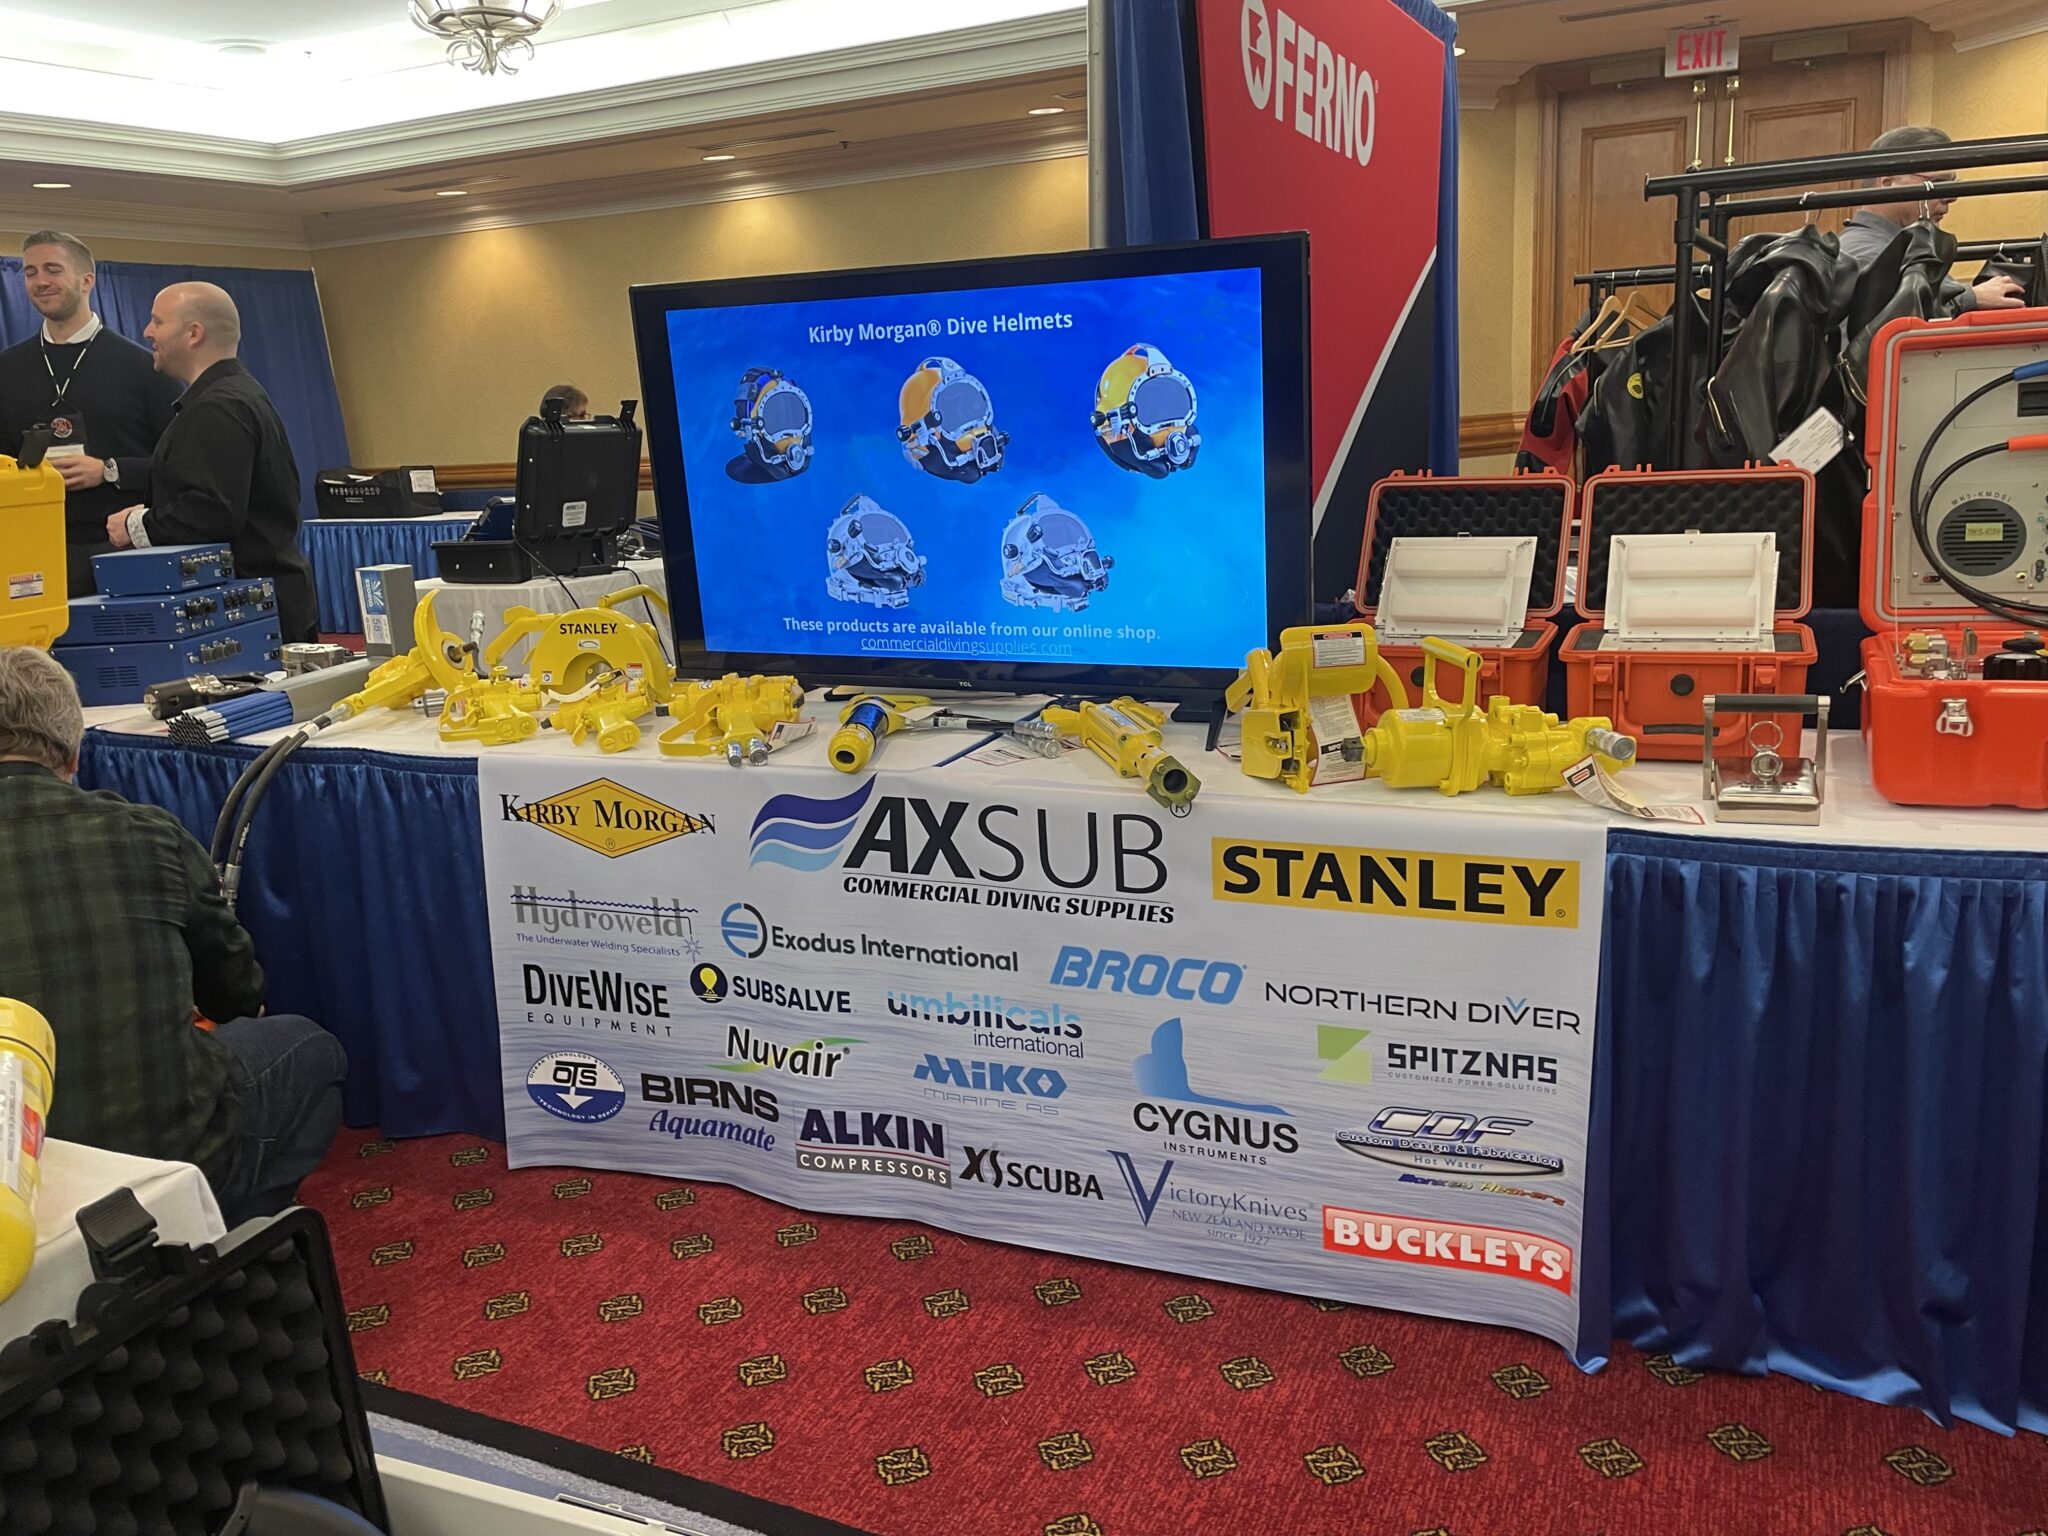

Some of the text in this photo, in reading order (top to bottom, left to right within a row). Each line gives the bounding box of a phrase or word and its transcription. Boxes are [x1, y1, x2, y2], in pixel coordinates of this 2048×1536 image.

[1676, 28, 1728, 71] EXIT
[1275, 8, 1375, 167] FERNO
[808, 325, 854, 346] Kirby
[947, 316, 988, 335] Dive
[993, 312, 1073, 333] Helmets
[560, 623, 617, 635] STANLEY
[783, 617, 1161, 643] These products are available from our online shop.
[861, 637, 1072, 656] commercialdivingsupplies.com
[499, 794, 716, 835] KIRBY MORGAN
[842, 795, 1169, 895] AXSUB
[843, 875, 1174, 925] COMMERCIAL DIVING SUPPLIES
[1222, 844, 1566, 918] STANLEY
[512, 885, 686, 937] Hydroweld
[516, 933, 680, 957] The Underwater Welding Specialists
[771, 926, 1018, 973] Exodus International
[732, 975, 852, 1014] SUBSALVE
[1050, 945, 1243, 1005] BROCO
[527, 1012, 672, 1037] EQUIPMENT
[886, 990, 1083, 1040] umbilicals
[1265, 981, 1582, 1035] NORTHERN DIVER
[727, 1025, 841, 1078] Nuvair
[973, 1028, 1085, 1059] international
[552, 1060, 598, 1087] OTS
[1387, 1042, 1558, 1085] SPITZNAS
[640, 1073, 780, 1123] BIRNS
[1388, 1072, 1557, 1095] CUSTOMIZED POWER SOLUTIONS
[1026, 1102, 1059, 1117] AS
[1133, 1102, 1299, 1154] CYGNUS
[1368, 1106, 1533, 1144] CDF
[649, 1109, 775, 1151] Aquamate
[799, 1108, 945, 1159] ALKIN
[1338, 1130, 1559, 1168] Custom Design & Fabrication
[799, 1153, 948, 1185] COMPRESSORS
[1164, 1141, 1267, 1166] INSTRUMENTS
[1413, 1155, 1484, 1170] Hot Water
[1007, 1162, 1104, 1201] SCUBA
[1172, 1208, 1306, 1240] NEW ZEALAND MADE
[1207, 1228, 1237, 1240] since
[1333, 1217, 1565, 1281] BUCKLEYS
